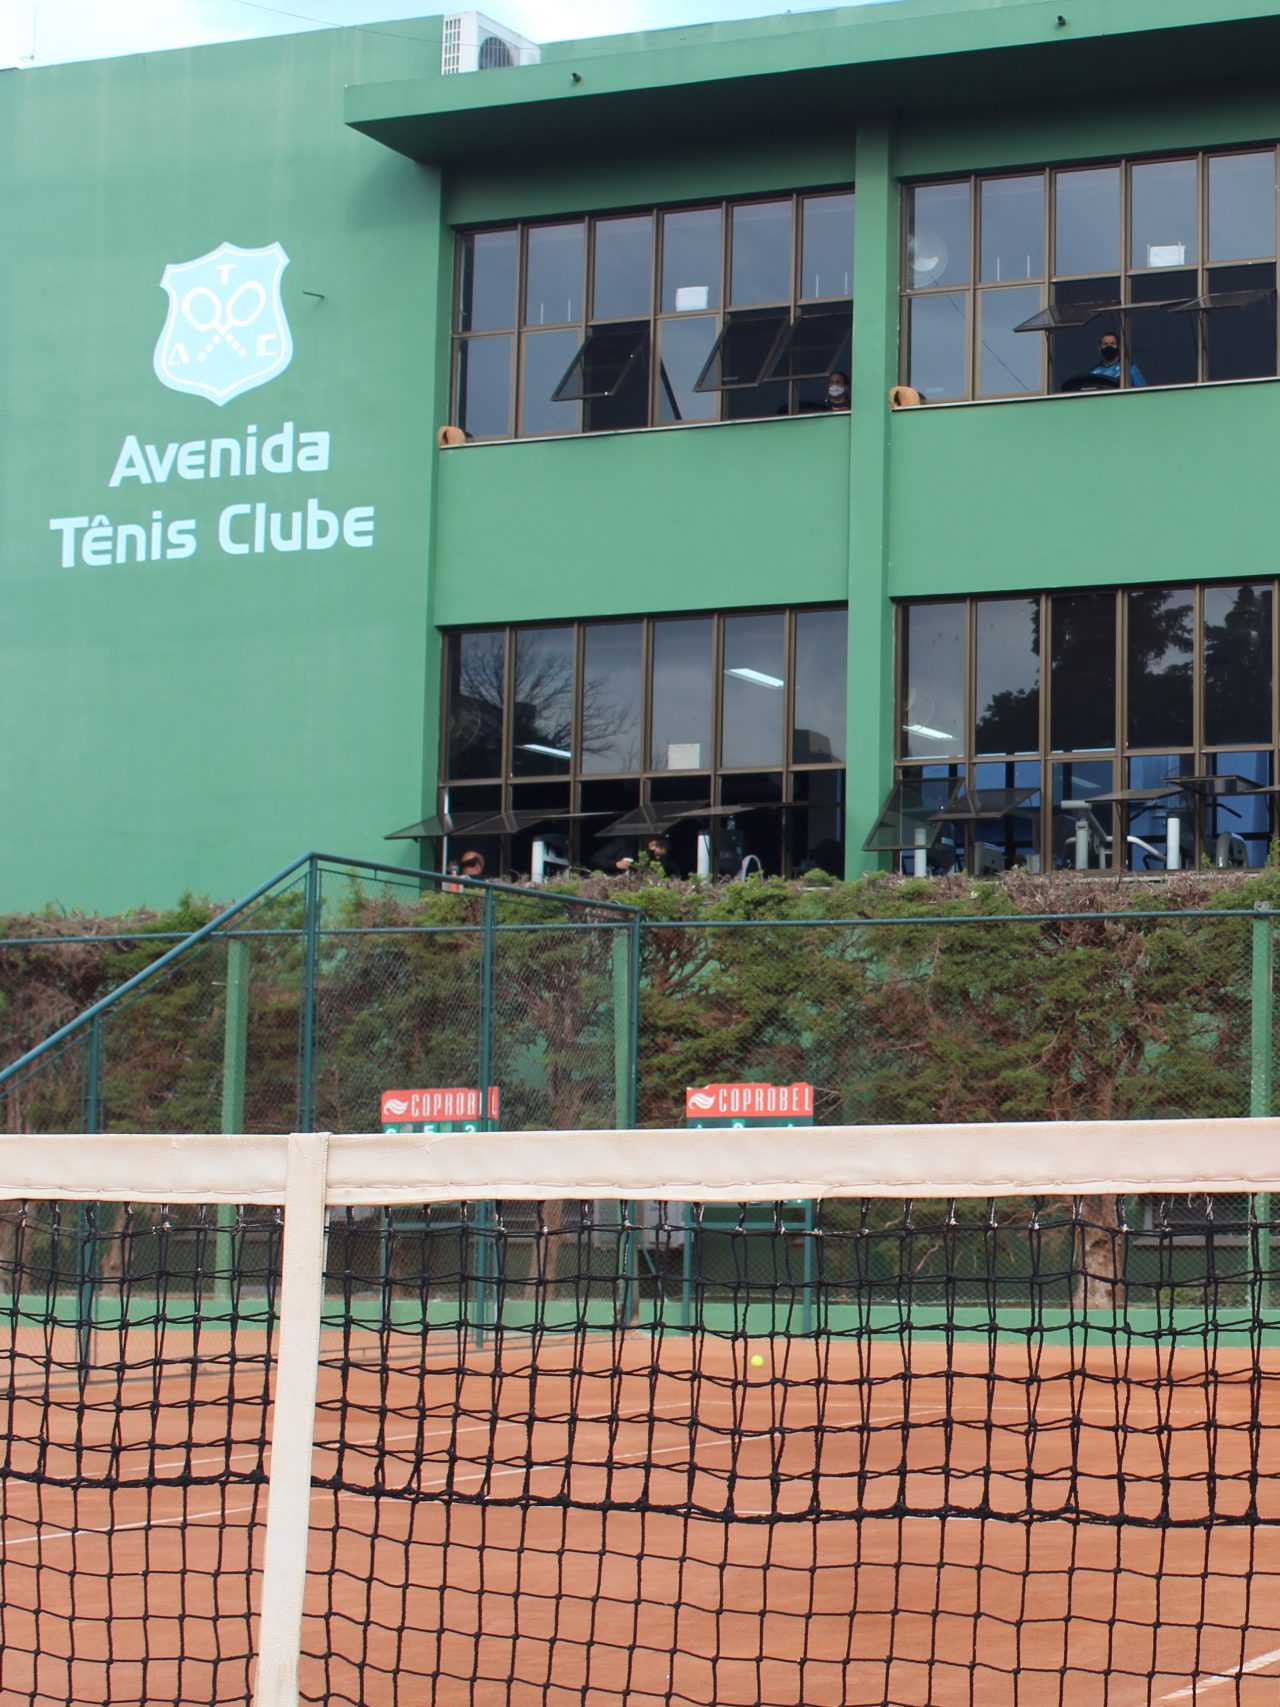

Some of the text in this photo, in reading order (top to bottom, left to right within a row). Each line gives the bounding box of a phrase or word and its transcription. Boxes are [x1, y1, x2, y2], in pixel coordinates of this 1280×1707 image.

[215, 263, 237, 286] T
[108, 421, 330, 488] Avenida
[49, 498, 374, 568] Tênis Clube
[718, 1087, 812, 1113] COPROBEL
